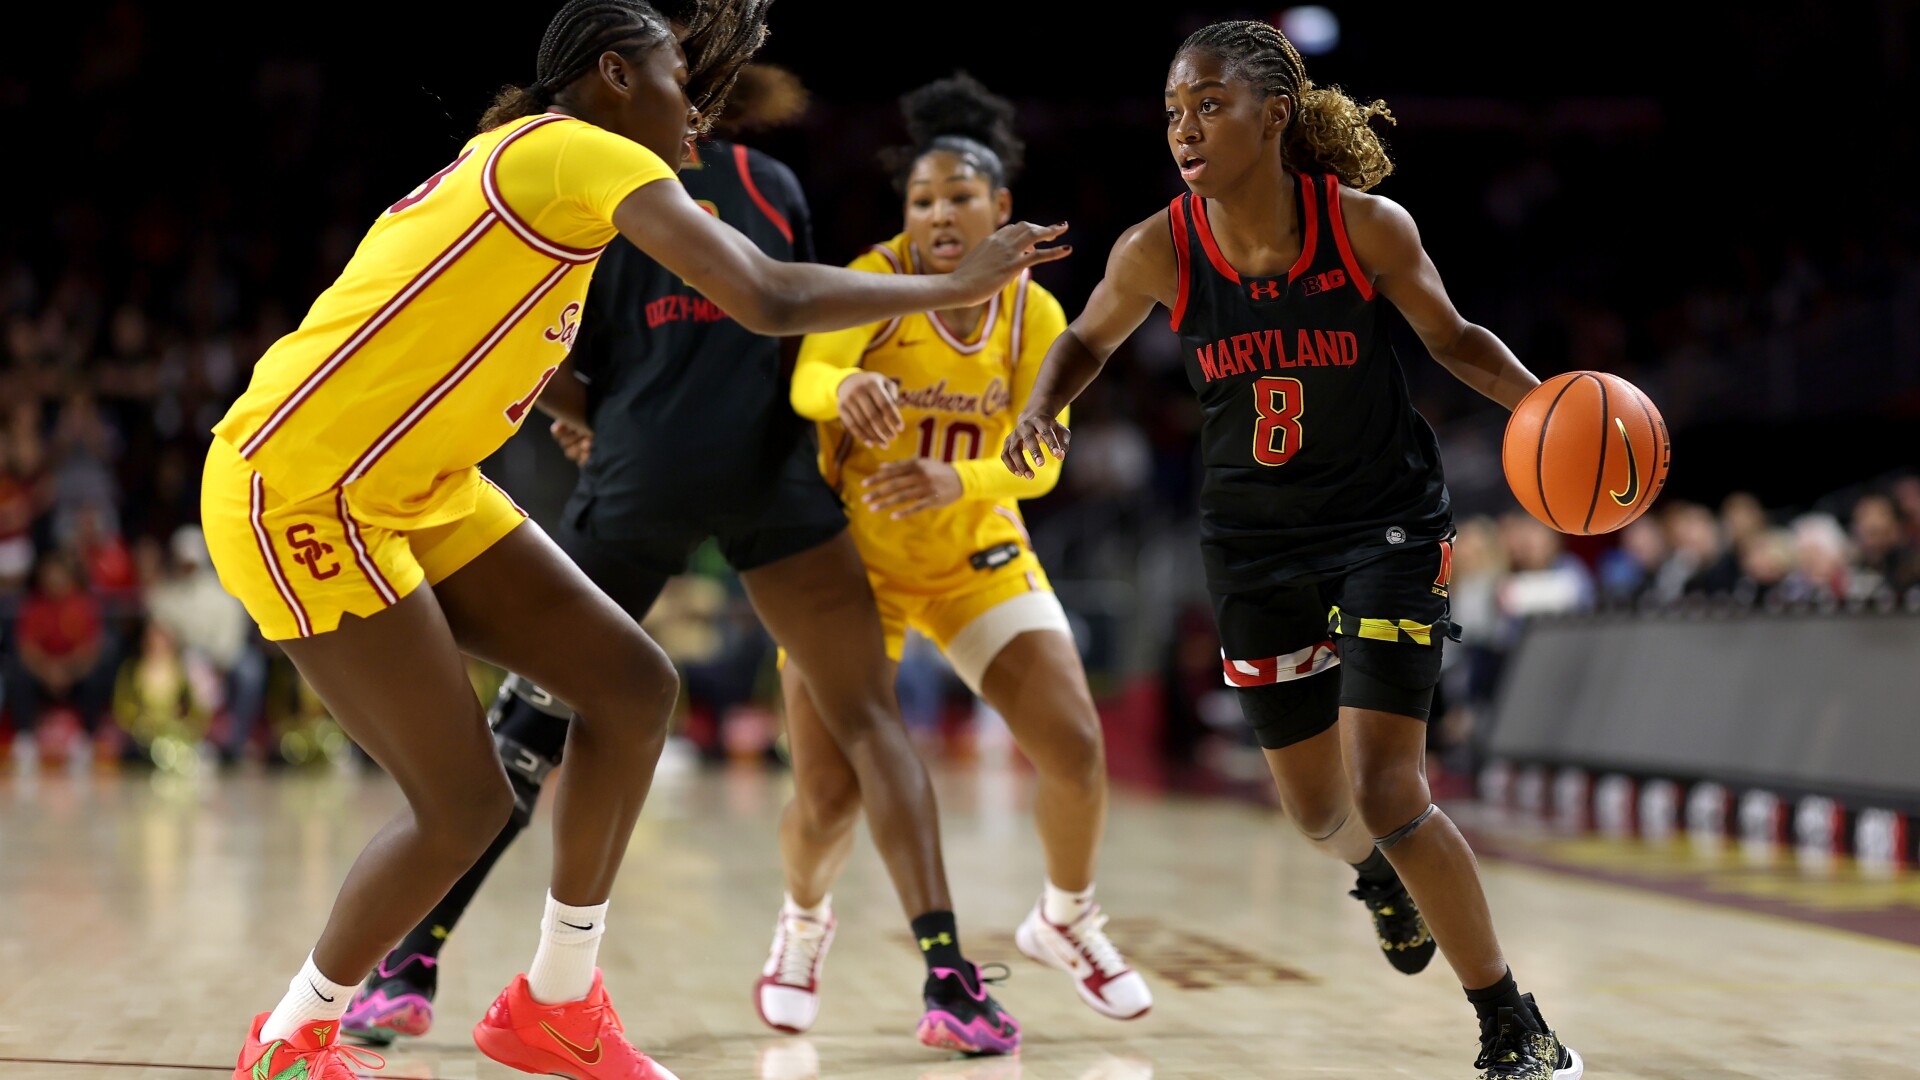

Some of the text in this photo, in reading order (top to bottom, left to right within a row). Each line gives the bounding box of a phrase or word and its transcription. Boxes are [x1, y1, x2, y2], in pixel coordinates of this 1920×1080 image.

[1197, 329, 1358, 383] MARYLAND
[890, 376, 978, 413] outhern
[1252, 376, 1304, 466] 8
[919, 416, 983, 463] 10
[286, 522, 341, 581] SC
